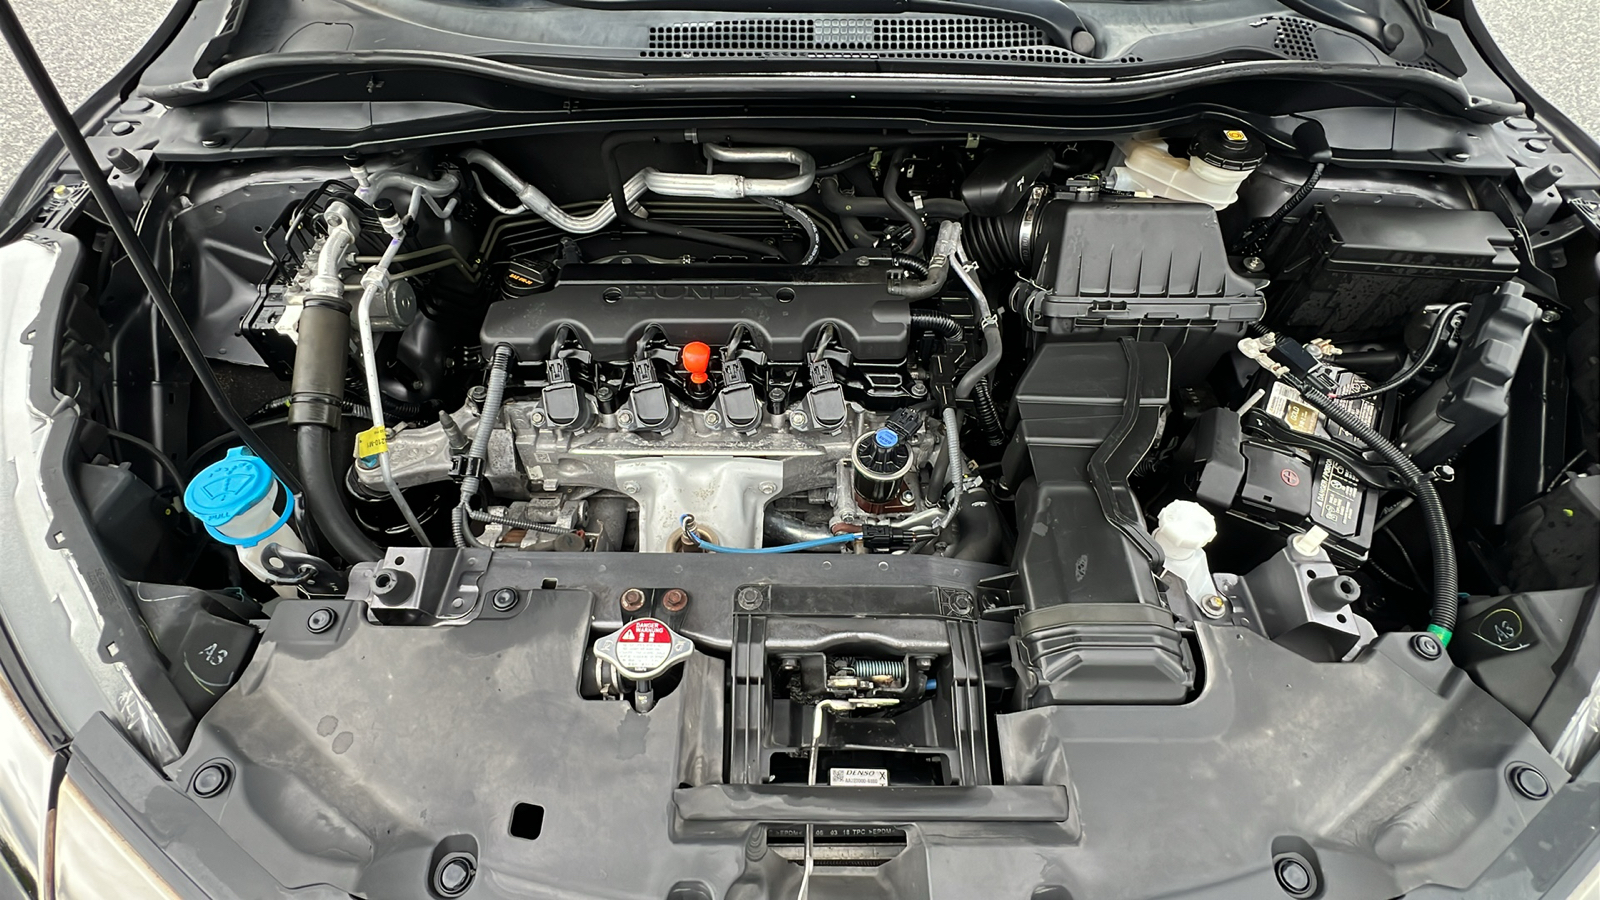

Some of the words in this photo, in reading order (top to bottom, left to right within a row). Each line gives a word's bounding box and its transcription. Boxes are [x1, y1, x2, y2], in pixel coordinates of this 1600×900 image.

[624, 285, 773, 300] HONDA
[208, 511, 230, 521] PULL
[198, 643, 228, 666] A3
